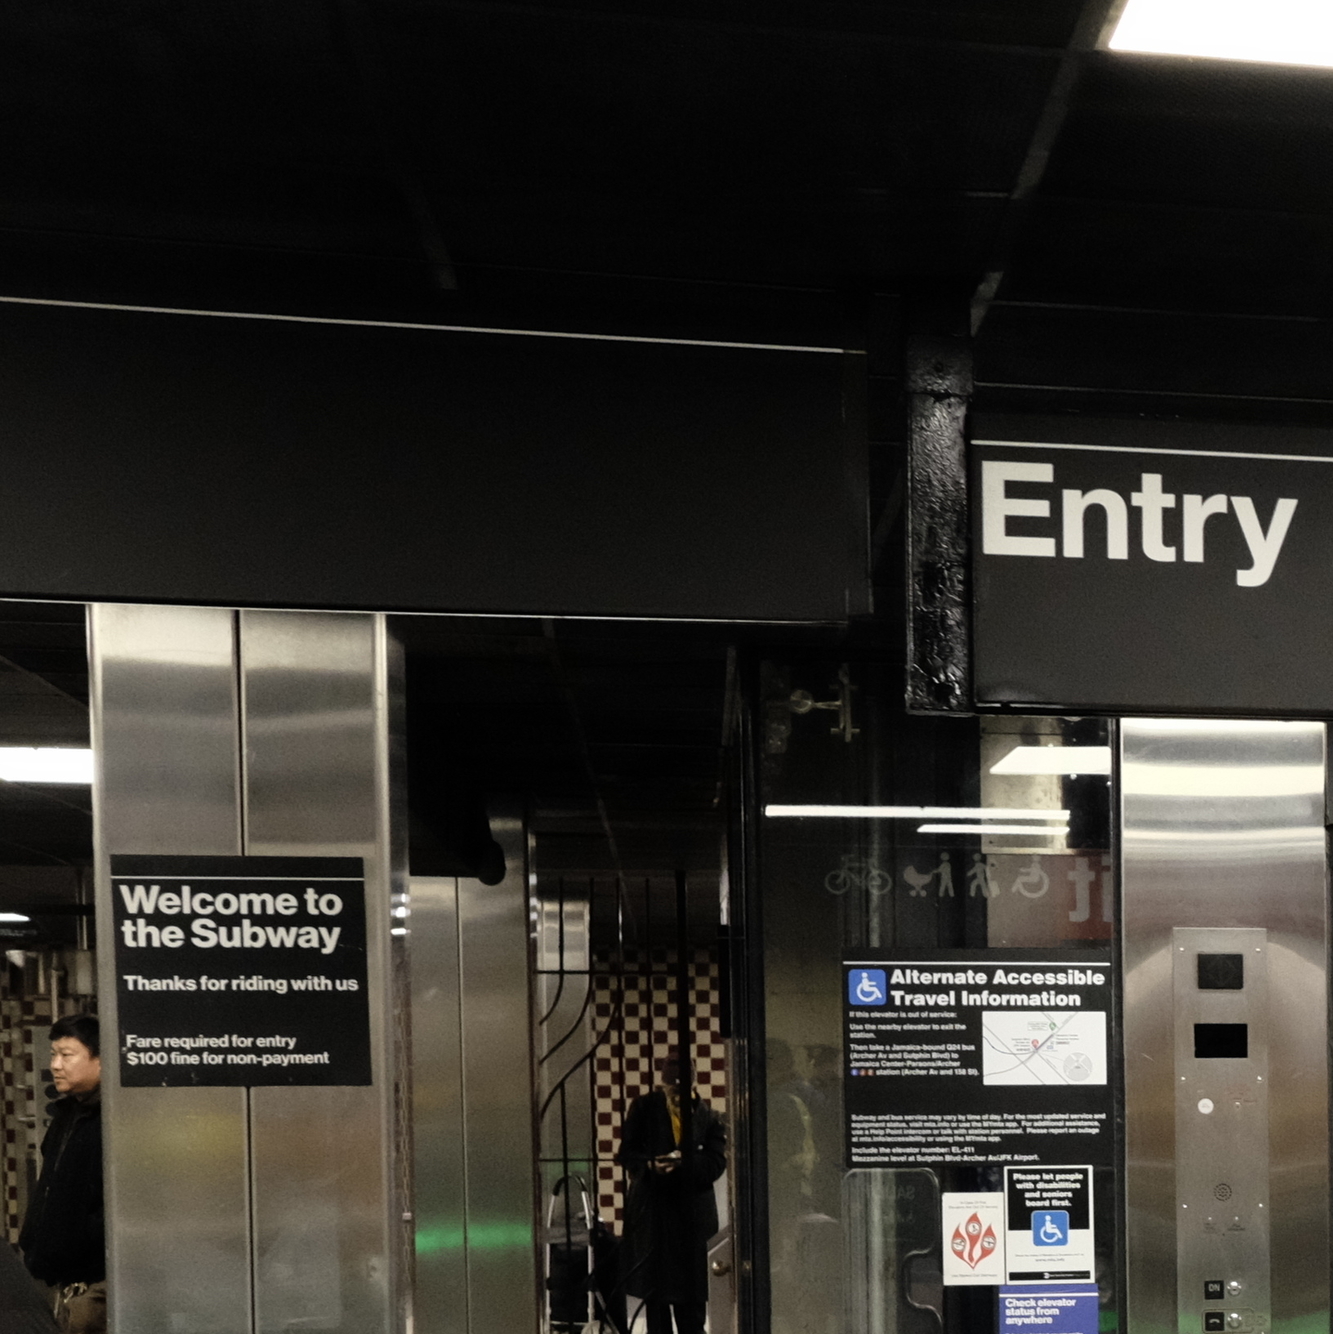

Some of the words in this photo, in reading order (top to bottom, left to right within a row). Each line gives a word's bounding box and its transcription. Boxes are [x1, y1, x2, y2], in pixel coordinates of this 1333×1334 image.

[982, 460, 1298, 587] Entry
[119, 885, 298, 916] Welcome
[304, 888, 343, 916] to
[121, 918, 185, 948] the
[191, 918, 341, 955] Subway
[123, 975, 197, 991] Thanks
[200, 975, 228, 991] for
[231, 975, 288, 994] riding
[290, 975, 332, 991] with
[335, 979, 359, 991] us
[890, 969, 987, 985] Alternate
[992, 969, 1105, 985] Accessible
[890, 990, 955, 1006] Travel
[961, 990, 1081, 1006] Information
[126, 1034, 161, 1048] Fare
[164, 1034, 229, 1051] required
[231, 1034, 254, 1048] for
[256, 1036, 296, 1050] entry
[126, 1052, 168, 1066] $100
[170, 1052, 200, 1065] fine
[202, 1052, 225, 1065] for
[227, 1052, 330, 1067] non-payment
[1013, 1172, 1040, 1180] Please
[1043, 1172, 1054, 1180] let
[1055, 1172, 1083, 1182] people
[1016, 1181, 1034, 1189] with
[1036, 1181, 1081, 1189] disabilities
[1024, 1190, 1040, 1198] and
[1042, 1190, 1072, 1198] seniors
[1208, 1283, 1221, 1292] DN
[1005, 1298, 1037, 1307] Check
[1037, 1298, 1076, 1307] elevator
[1005, 1307, 1035, 1316] status
[1036, 1307, 1059, 1316] from
[1005, 1316, 1053, 1326] anywhere
